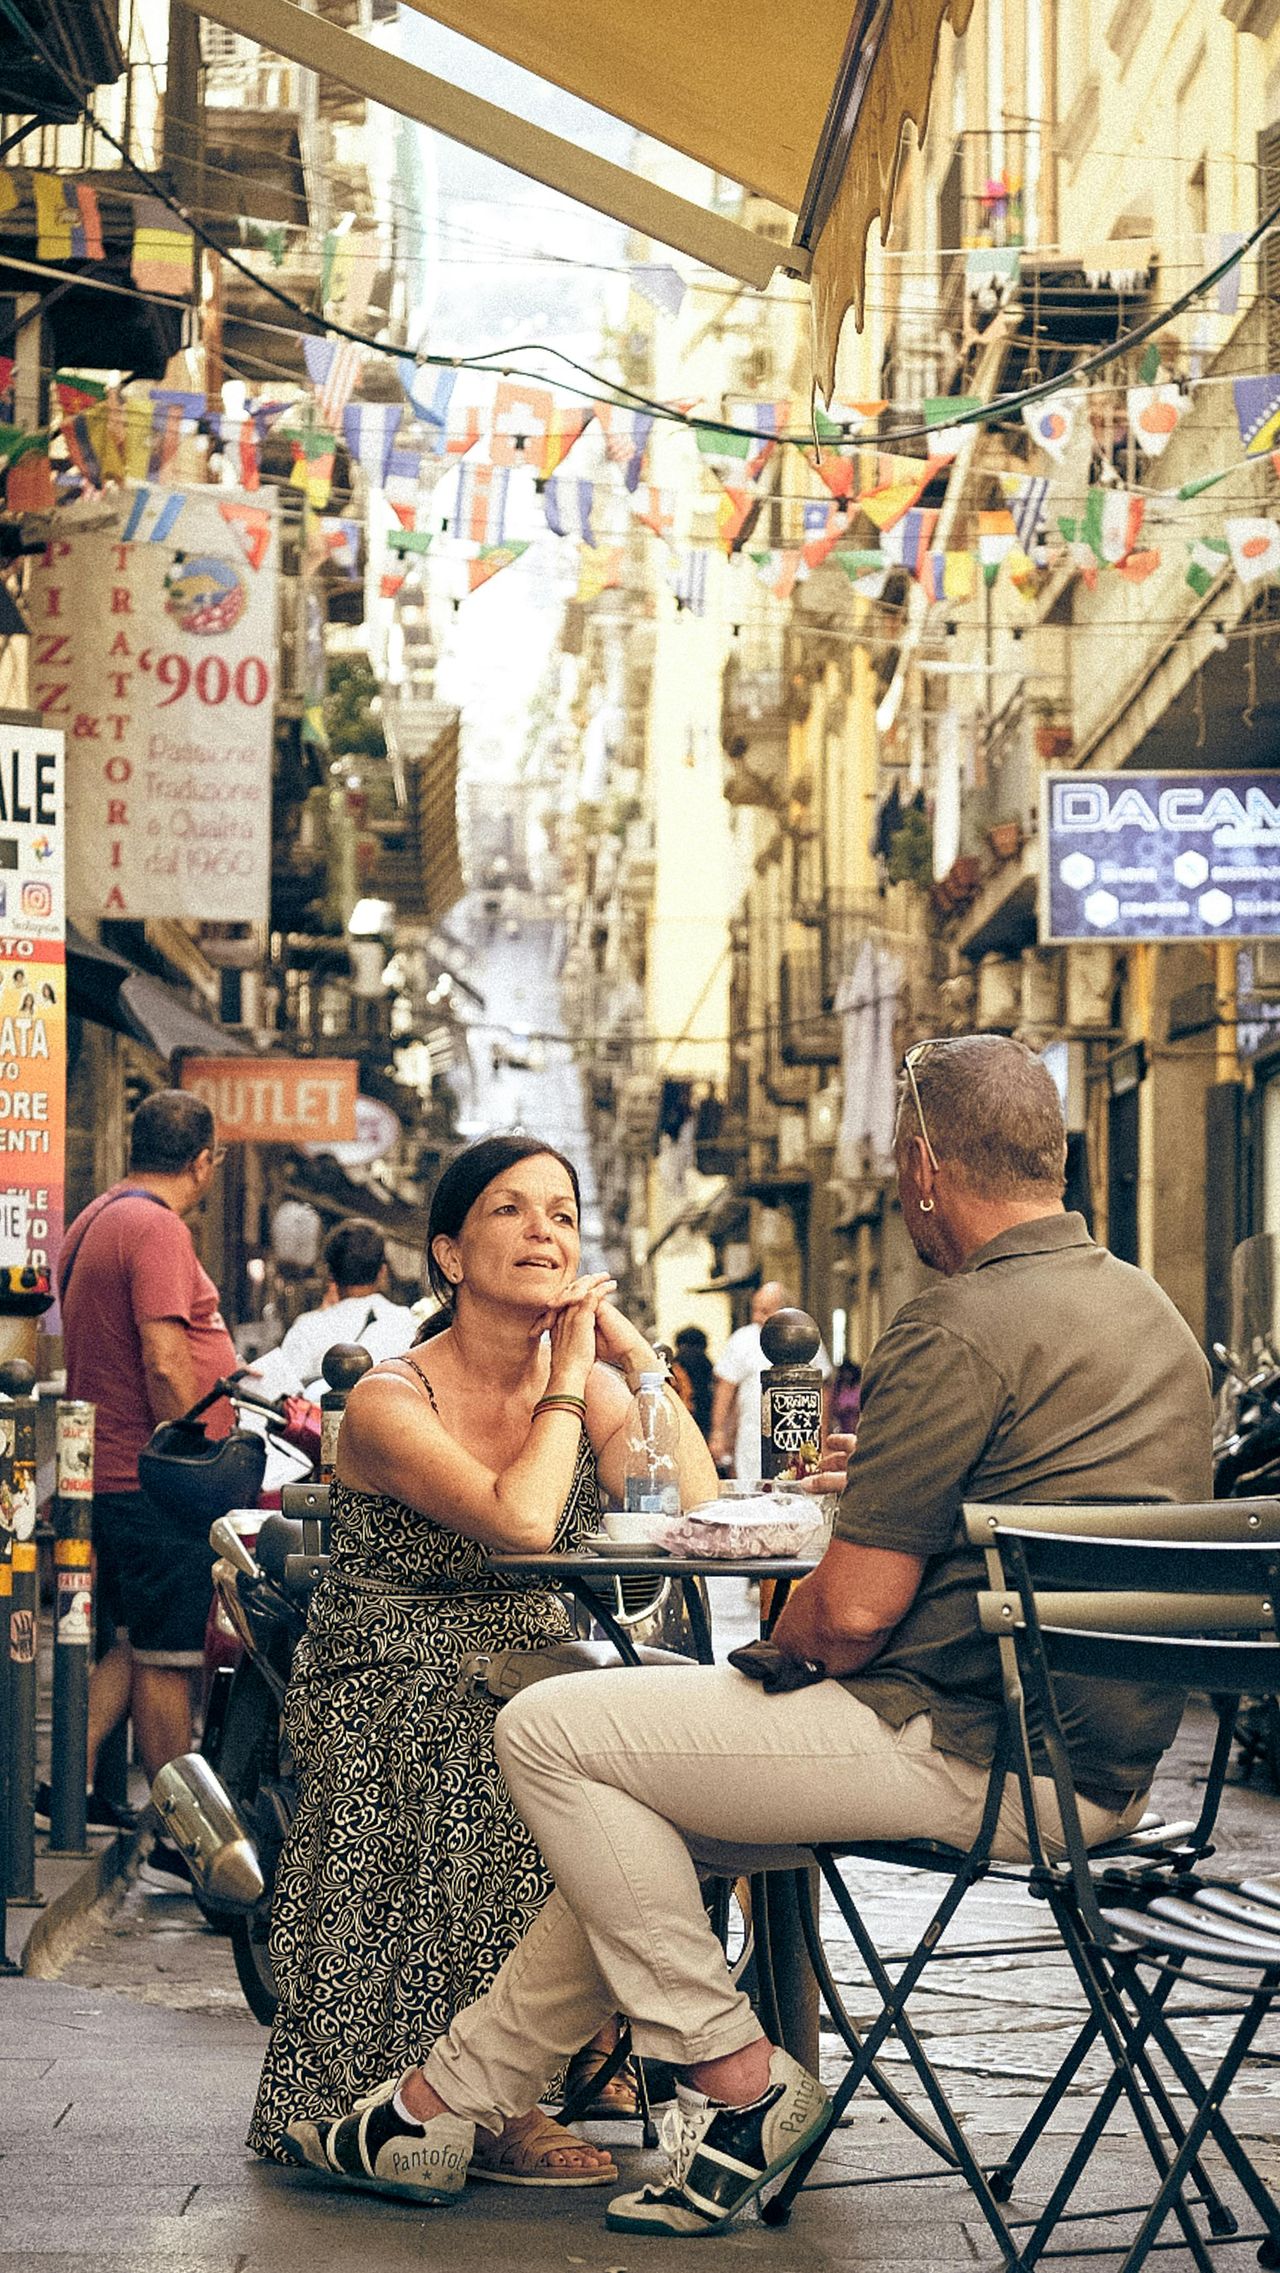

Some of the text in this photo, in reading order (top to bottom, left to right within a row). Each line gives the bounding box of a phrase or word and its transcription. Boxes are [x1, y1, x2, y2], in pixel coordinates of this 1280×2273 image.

[73, 713, 100, 740] &
[105, 543, 135, 910] TRATTORIA
[191, 1077, 345, 1126] OUTLET
